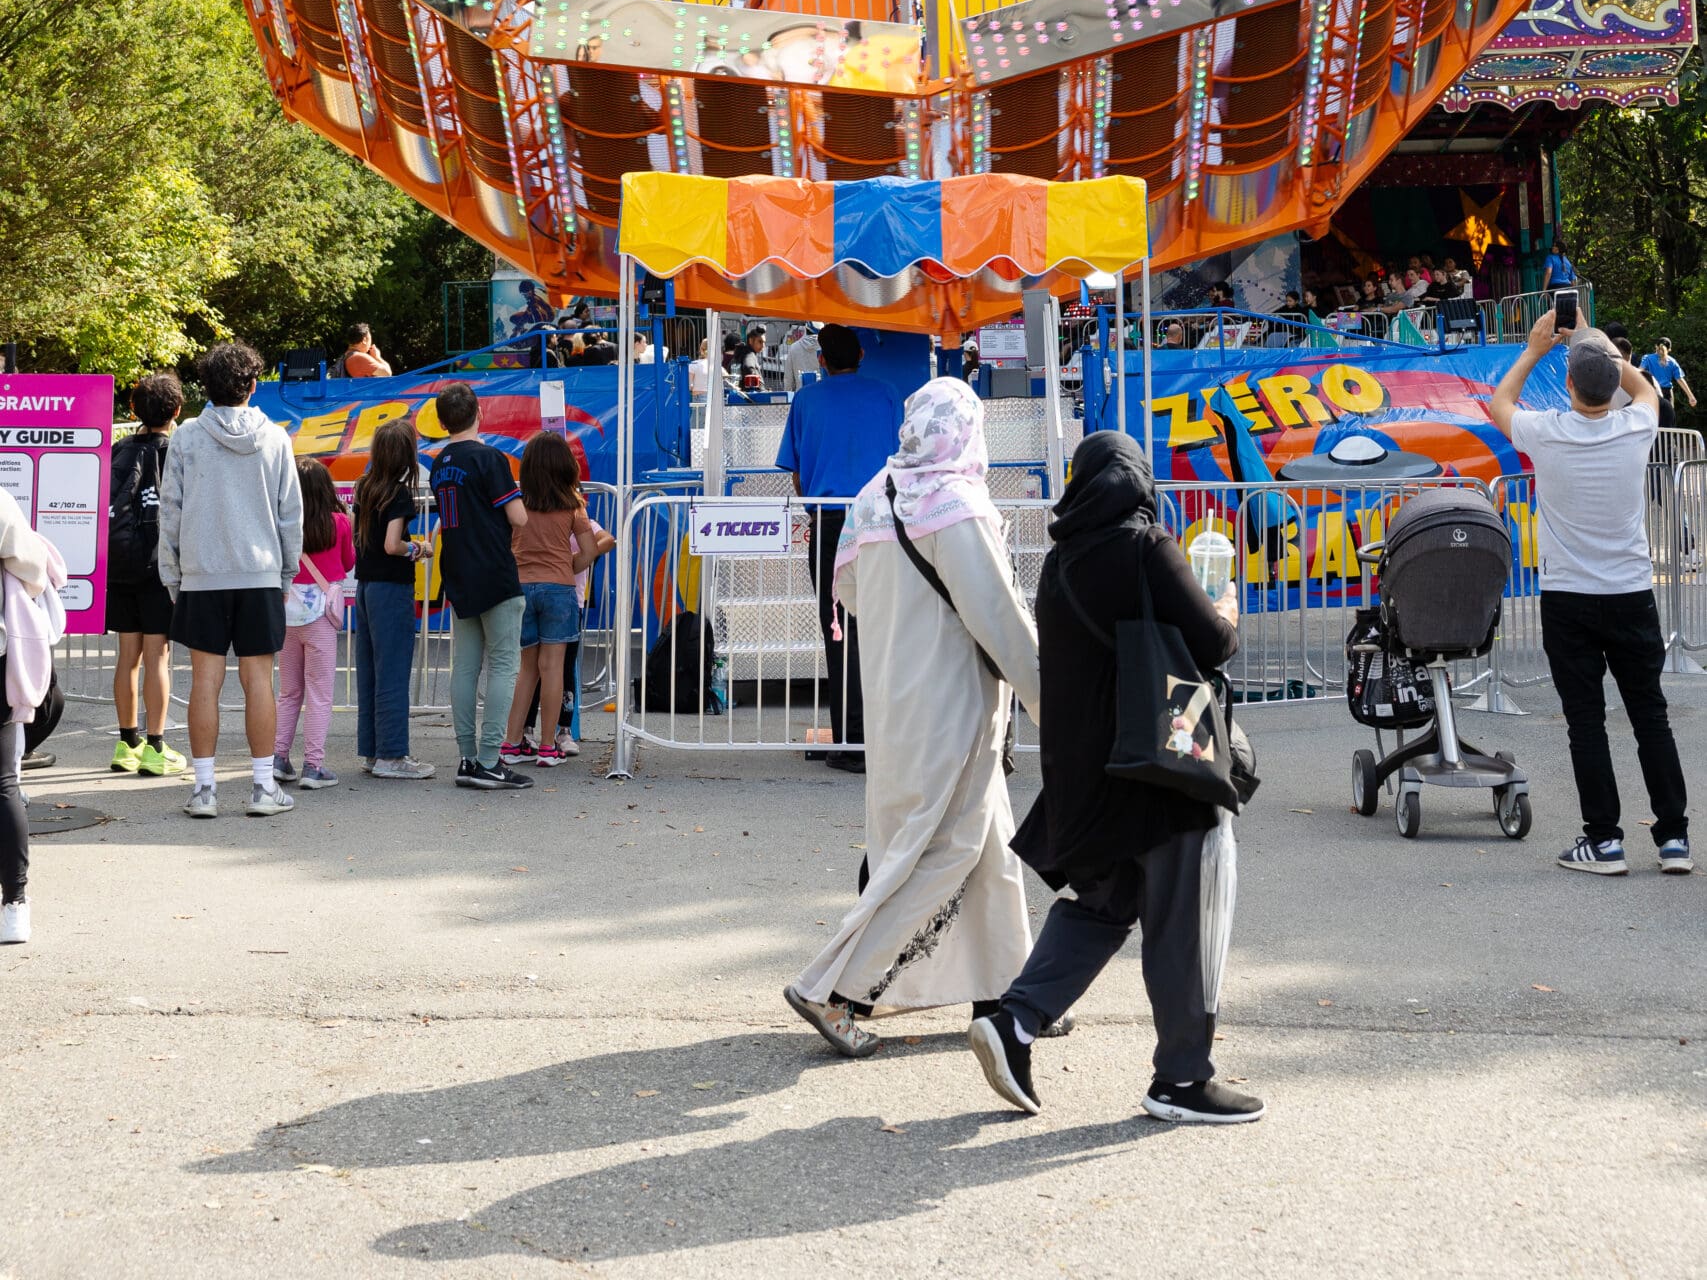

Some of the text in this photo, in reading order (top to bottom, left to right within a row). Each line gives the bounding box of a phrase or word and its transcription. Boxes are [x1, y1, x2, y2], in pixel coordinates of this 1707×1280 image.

[0, 396, 76, 411] GRAVITY
[1141, 364, 1384, 448] ZERO
[16, 430, 75, 444] GUIDE
[438, 486, 459, 529] 11
[700, 521, 780, 536] 4 TICKETS
[792, 524, 811, 543] Ze
[1178, 502, 1539, 583] GRAVY
